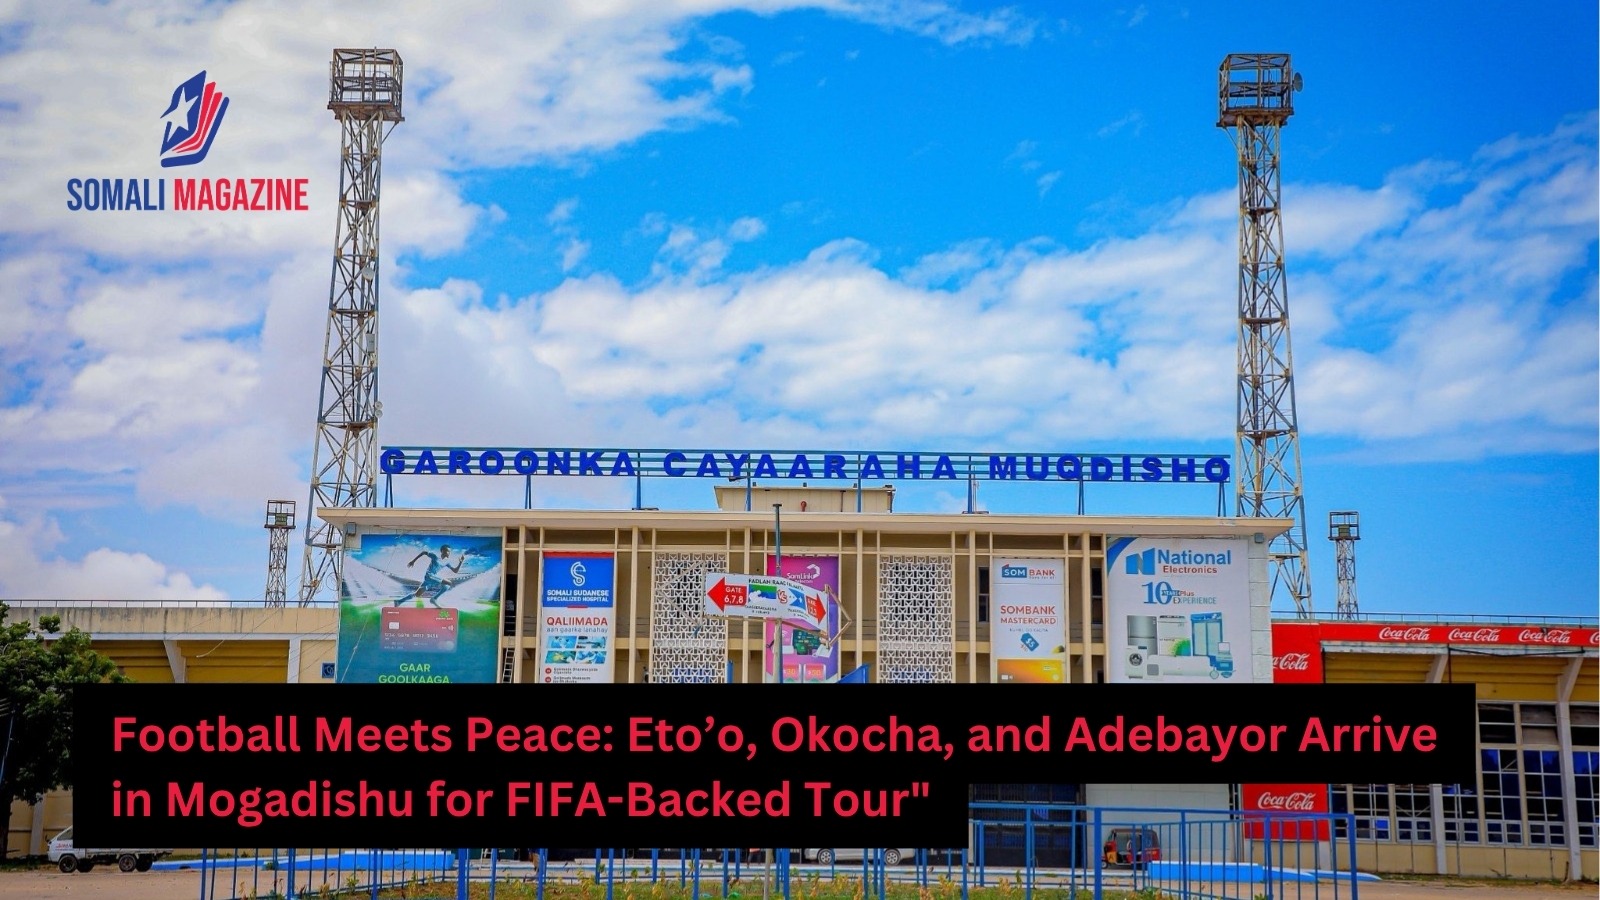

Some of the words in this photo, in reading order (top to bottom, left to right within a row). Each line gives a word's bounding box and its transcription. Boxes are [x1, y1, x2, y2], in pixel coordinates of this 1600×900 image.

[380, 449, 636, 477] GAROONKA
[663, 452, 957, 480] CAYAARAHA
[989, 454, 1231, 482] MUQDISHO
[1158, 549, 1231, 565] National
[1163, 565, 1217, 574] Electronics
[724, 594, 744, 605] 6,7,8
[1142, 581, 1173, 605] 10
[1173, 597, 1218, 605] EXPERIENCE
[1000, 605, 1056, 615] SOMBANK
[546, 617, 608, 626] QALIIMADA
[1000, 617, 1057, 625] MASTERCARD
[1379, 627, 1431, 642] Coca-Cola
[1449, 627, 1501, 642] Coca-Cola
[1518, 628, 1572, 644] Coca-Cola
[399, 663, 431, 672] GAAR
[1258, 791, 1316, 811] Coca-Cola
